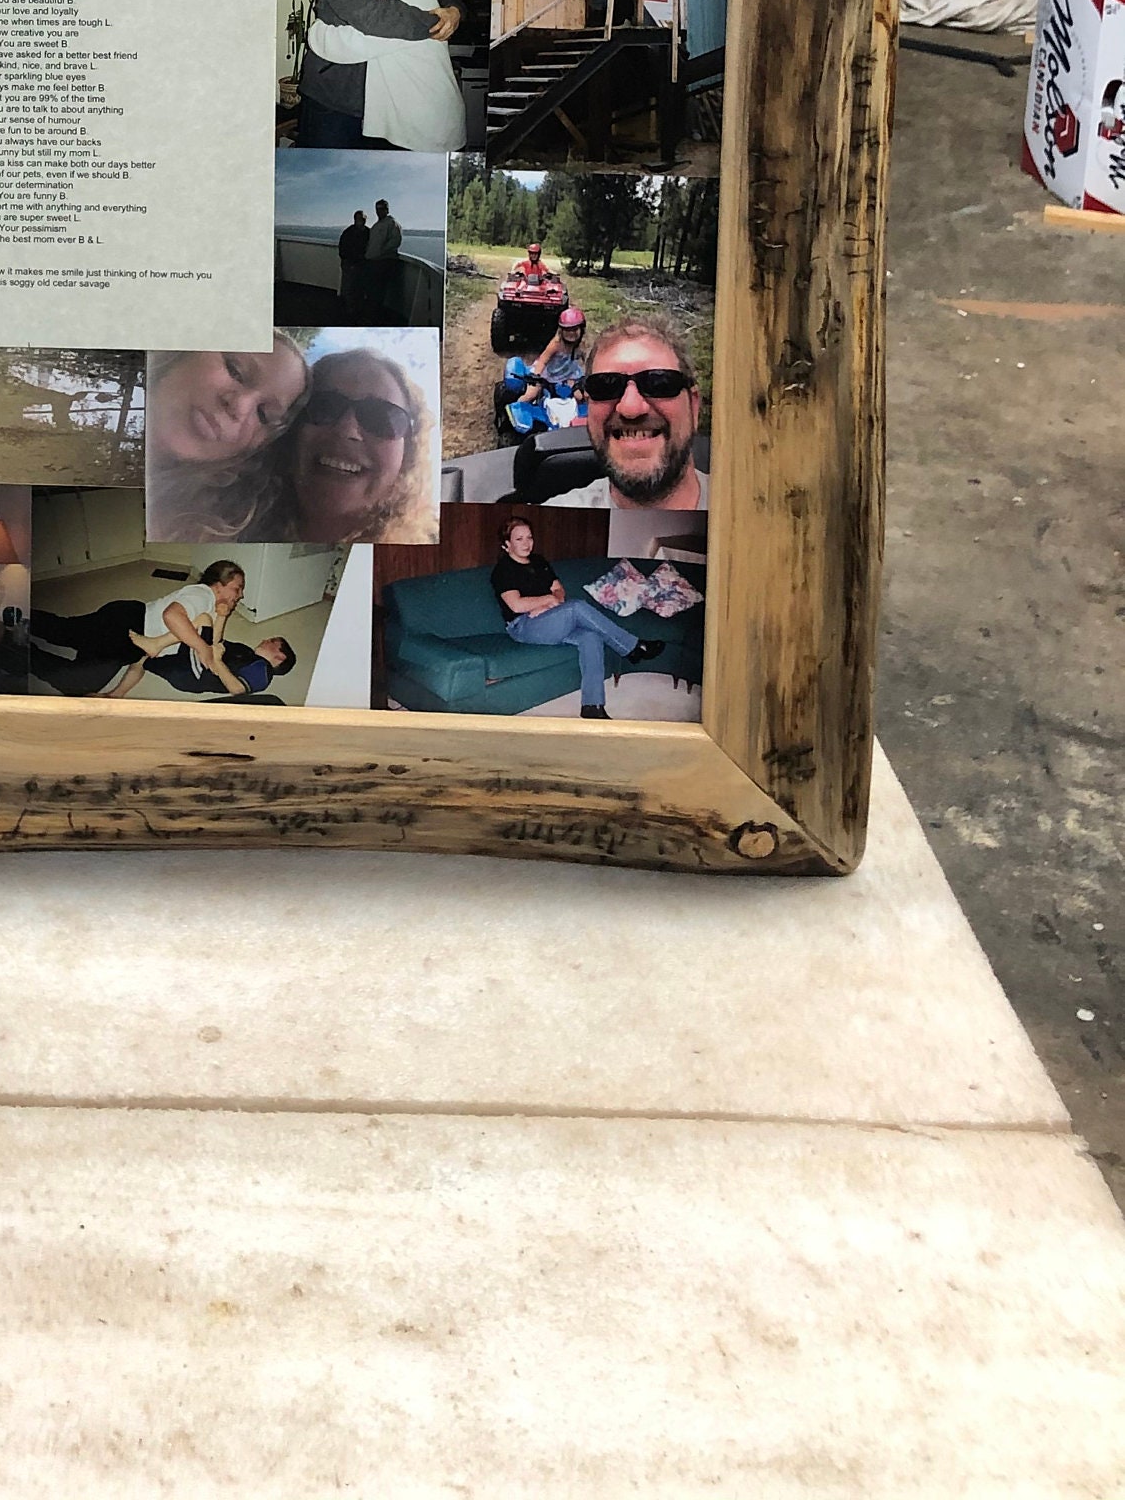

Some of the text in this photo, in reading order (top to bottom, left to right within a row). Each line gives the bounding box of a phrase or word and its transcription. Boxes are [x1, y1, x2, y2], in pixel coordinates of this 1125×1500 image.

[16, 50, 42, 58] asked
[44, 50, 56, 58] for
[66, 51, 91, 59] better
[93, 51, 111, 59] best
[113, 51, 138, 59] friend
[4, 72, 42, 82] sparkling
[45, 72, 63, 80] blue
[65, 74, 86, 83] eyes
[1032, 47, 1047, 135] CANADIAN
[5, 95, 20, 103] you
[39, 93, 58, 102] 99%
[60, 94, 69, 102] of
[71, 94, 85, 102] the
[87, 94, 105, 102] time
[22, 104, 31, 113] to
[32, 105, 48, 113] talk
[50, 105, 59, 113] to
[61, 105, 85, 113] about
[87, 105, 124, 116] anything
[5, 137, 34, 147] always
[37, 137, 58, 145] have
[76, 138, 102, 146] backs
[15, 181, 73, 189] determination
[26, 202, 43, 210] with
[45, 202, 82, 213] anything
[84, 203, 100, 211] and
[102, 203, 147, 214] everything
[0, 223, 67, 234] Your pessimism
[9, 279, 35, 288] soggy
[37, 278, 50, 286] old
[52, 278, 77, 287] cedar
[79, 281, 110, 289] savage
